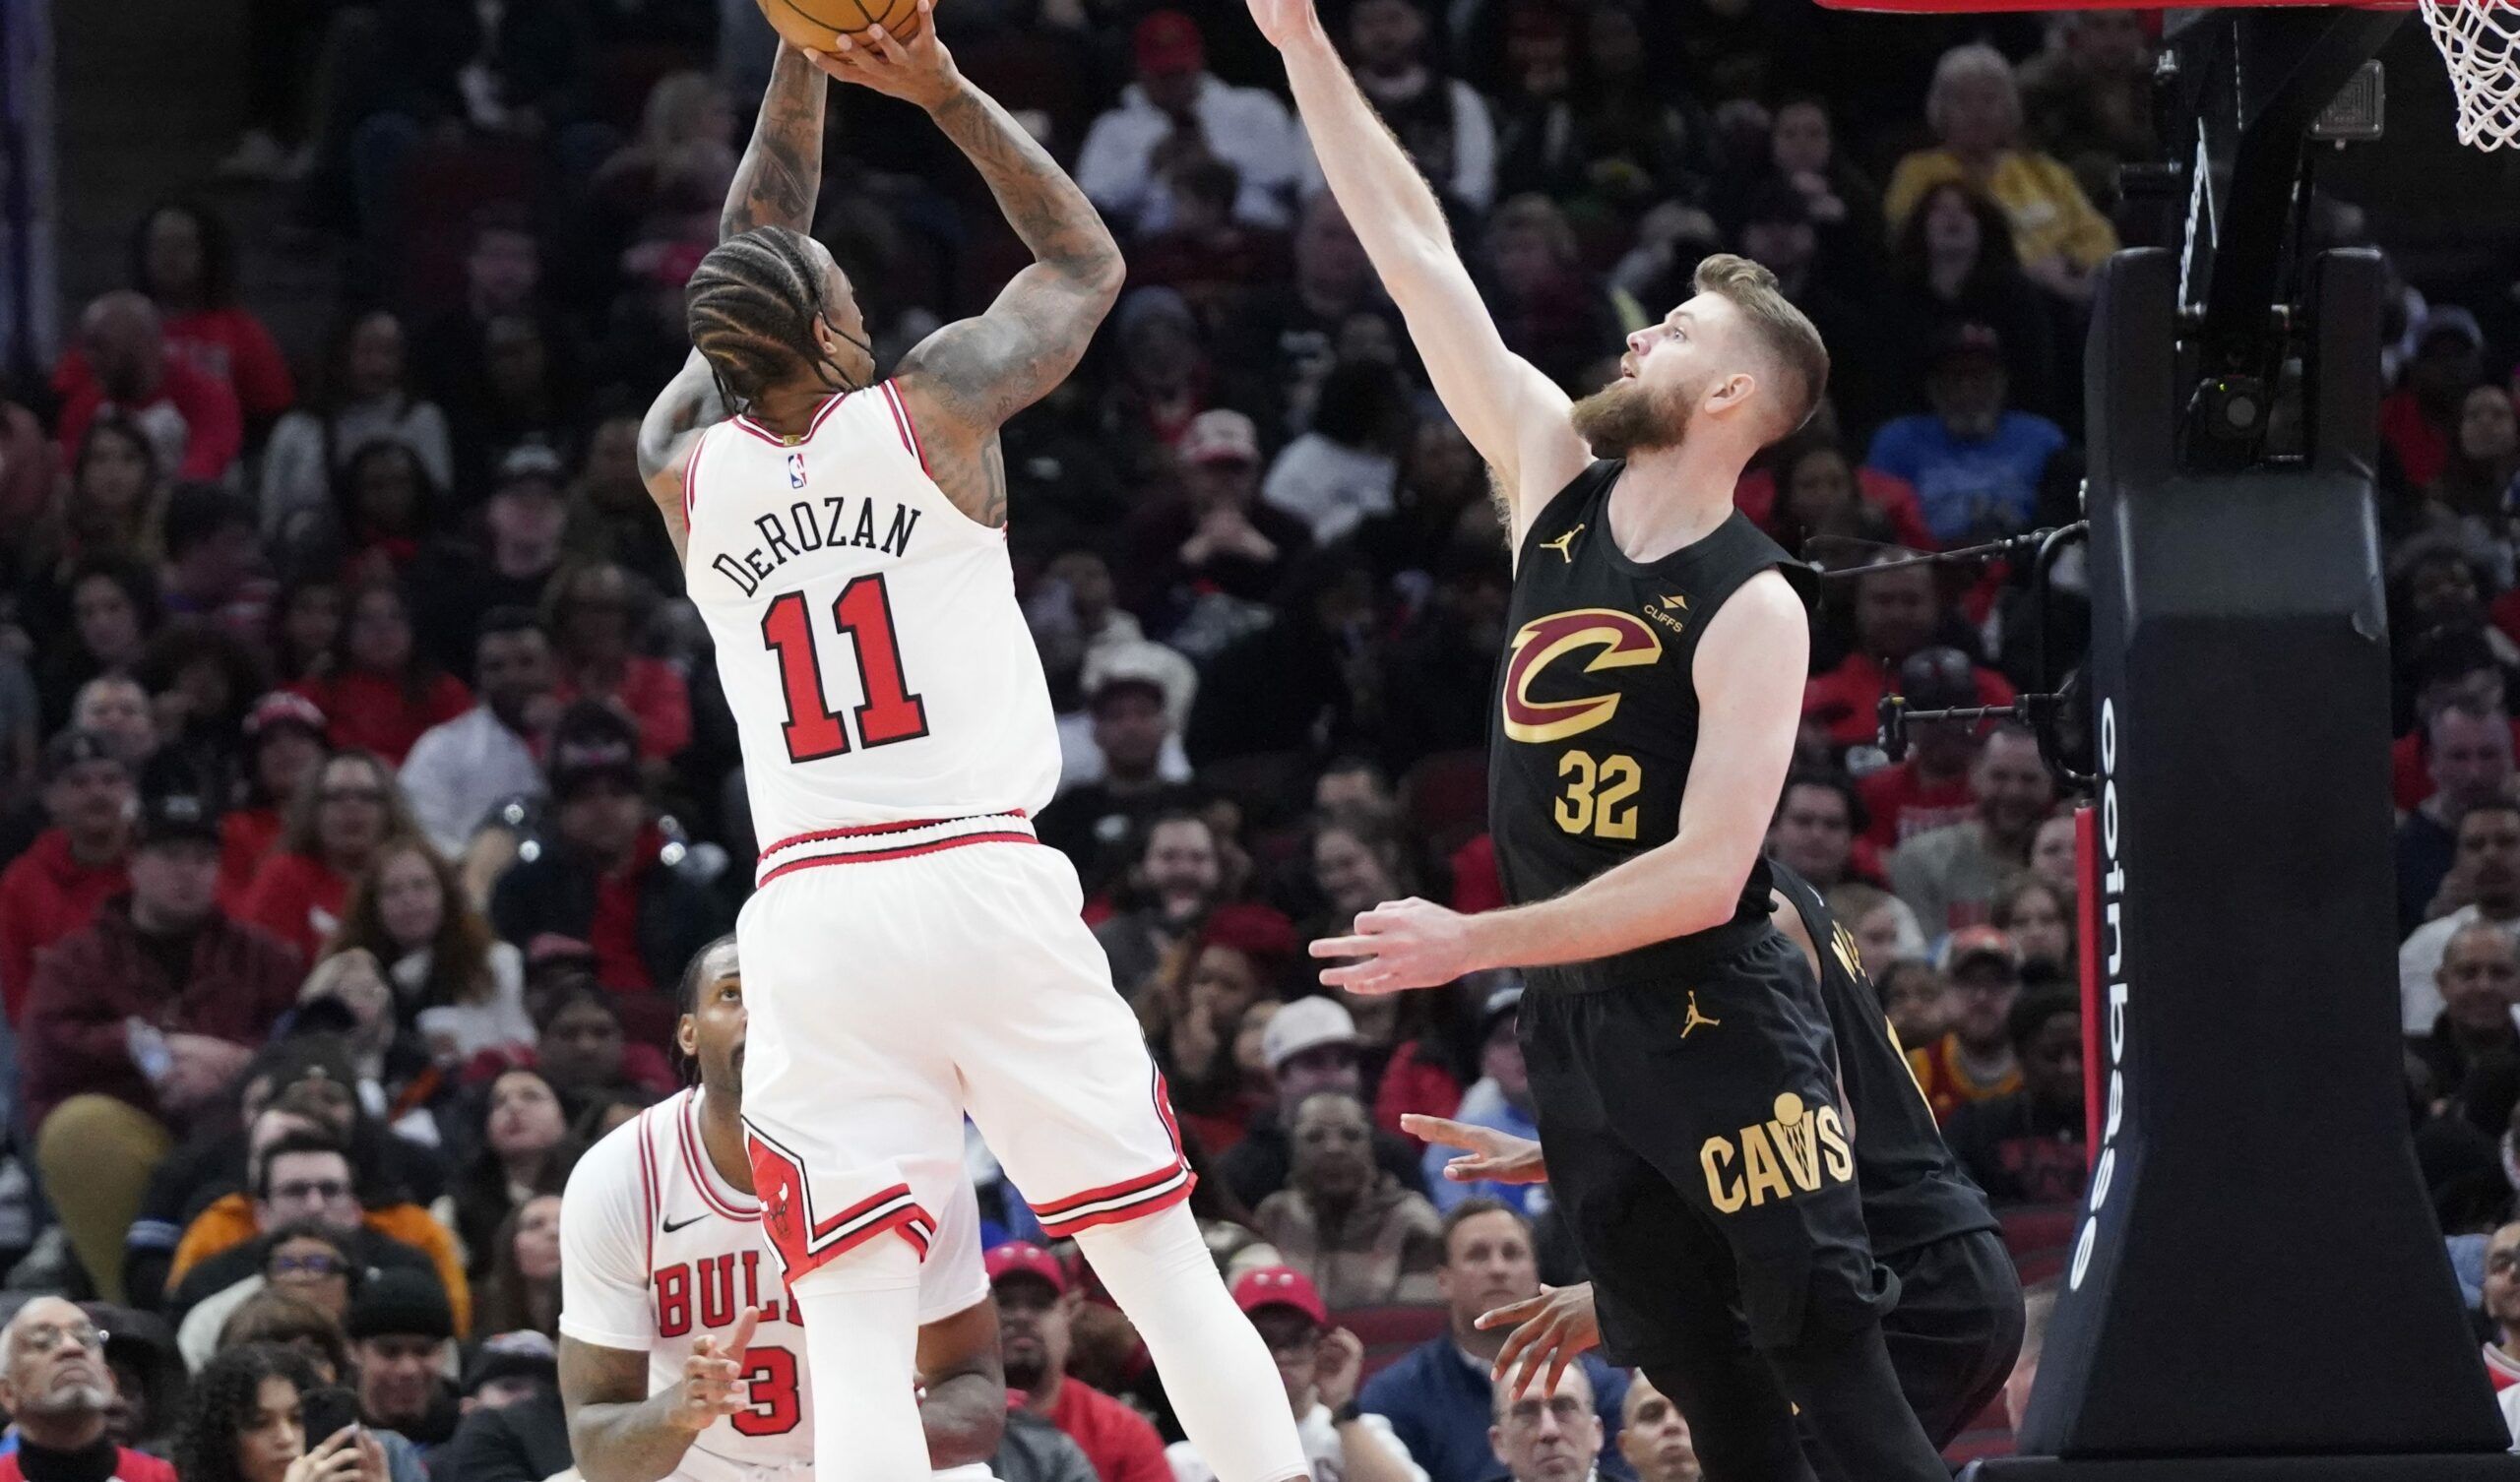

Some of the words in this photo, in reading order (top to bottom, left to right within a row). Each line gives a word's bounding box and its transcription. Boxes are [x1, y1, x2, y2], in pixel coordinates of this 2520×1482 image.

[761, 572, 929, 765] 11
[1643, 604, 1683, 633] CLIFFS
[1502, 608, 1663, 743] C
[1555, 749, 1642, 839] 32
[2070, 697, 2128, 1292] coinbase
[1700, 1103, 1854, 1214] CAVS
[654, 1250, 805, 1338] BUL
[730, 1345, 801, 1437] 3
